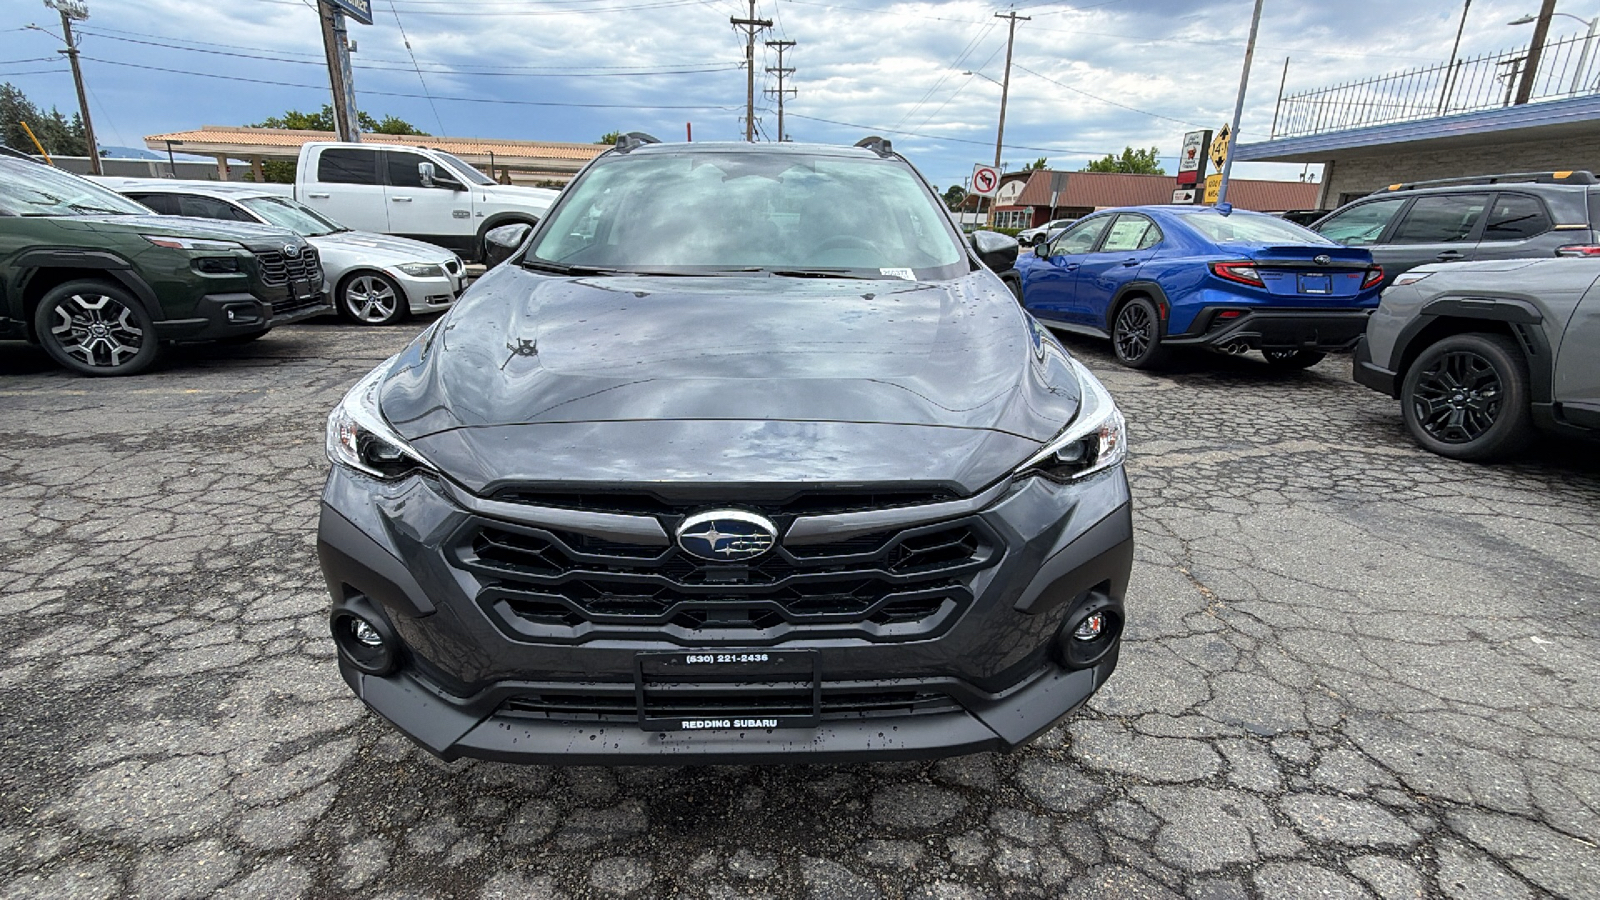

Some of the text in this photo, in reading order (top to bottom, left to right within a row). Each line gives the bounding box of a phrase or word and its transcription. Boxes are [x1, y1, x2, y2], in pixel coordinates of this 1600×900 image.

[717, 653, 768, 662] 221-2436
[682, 719, 778, 729] REDDING SUBARU
